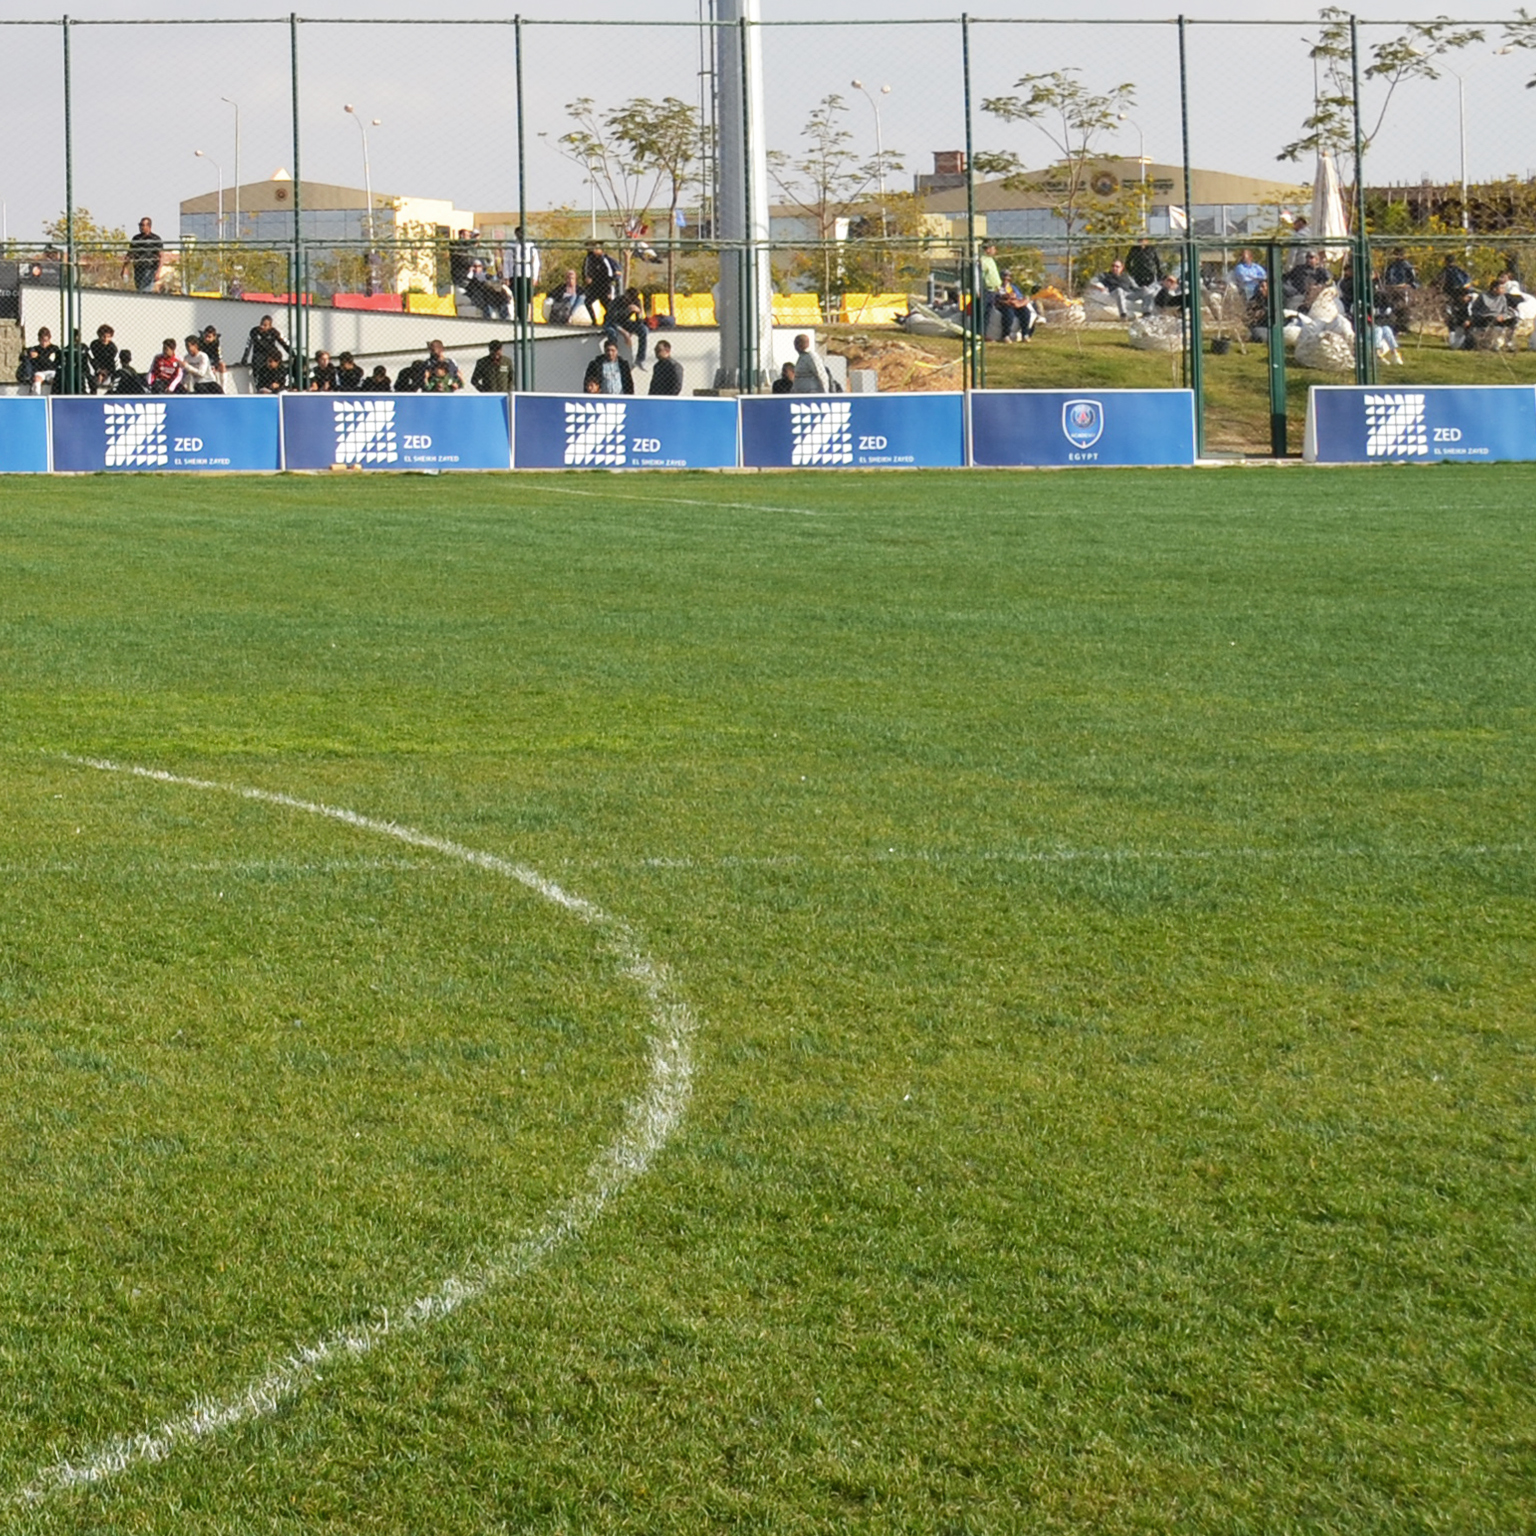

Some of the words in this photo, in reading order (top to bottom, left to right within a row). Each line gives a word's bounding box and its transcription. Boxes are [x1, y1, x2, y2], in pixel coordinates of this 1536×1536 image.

[1433, 427, 1462, 442] ZED
[174, 437, 204, 452] ZED
[403, 435, 432, 449] ZED
[632, 438, 661, 453] ZED
[858, 436, 888, 450] ZED
[1068, 452, 1099, 461] EGYPT
